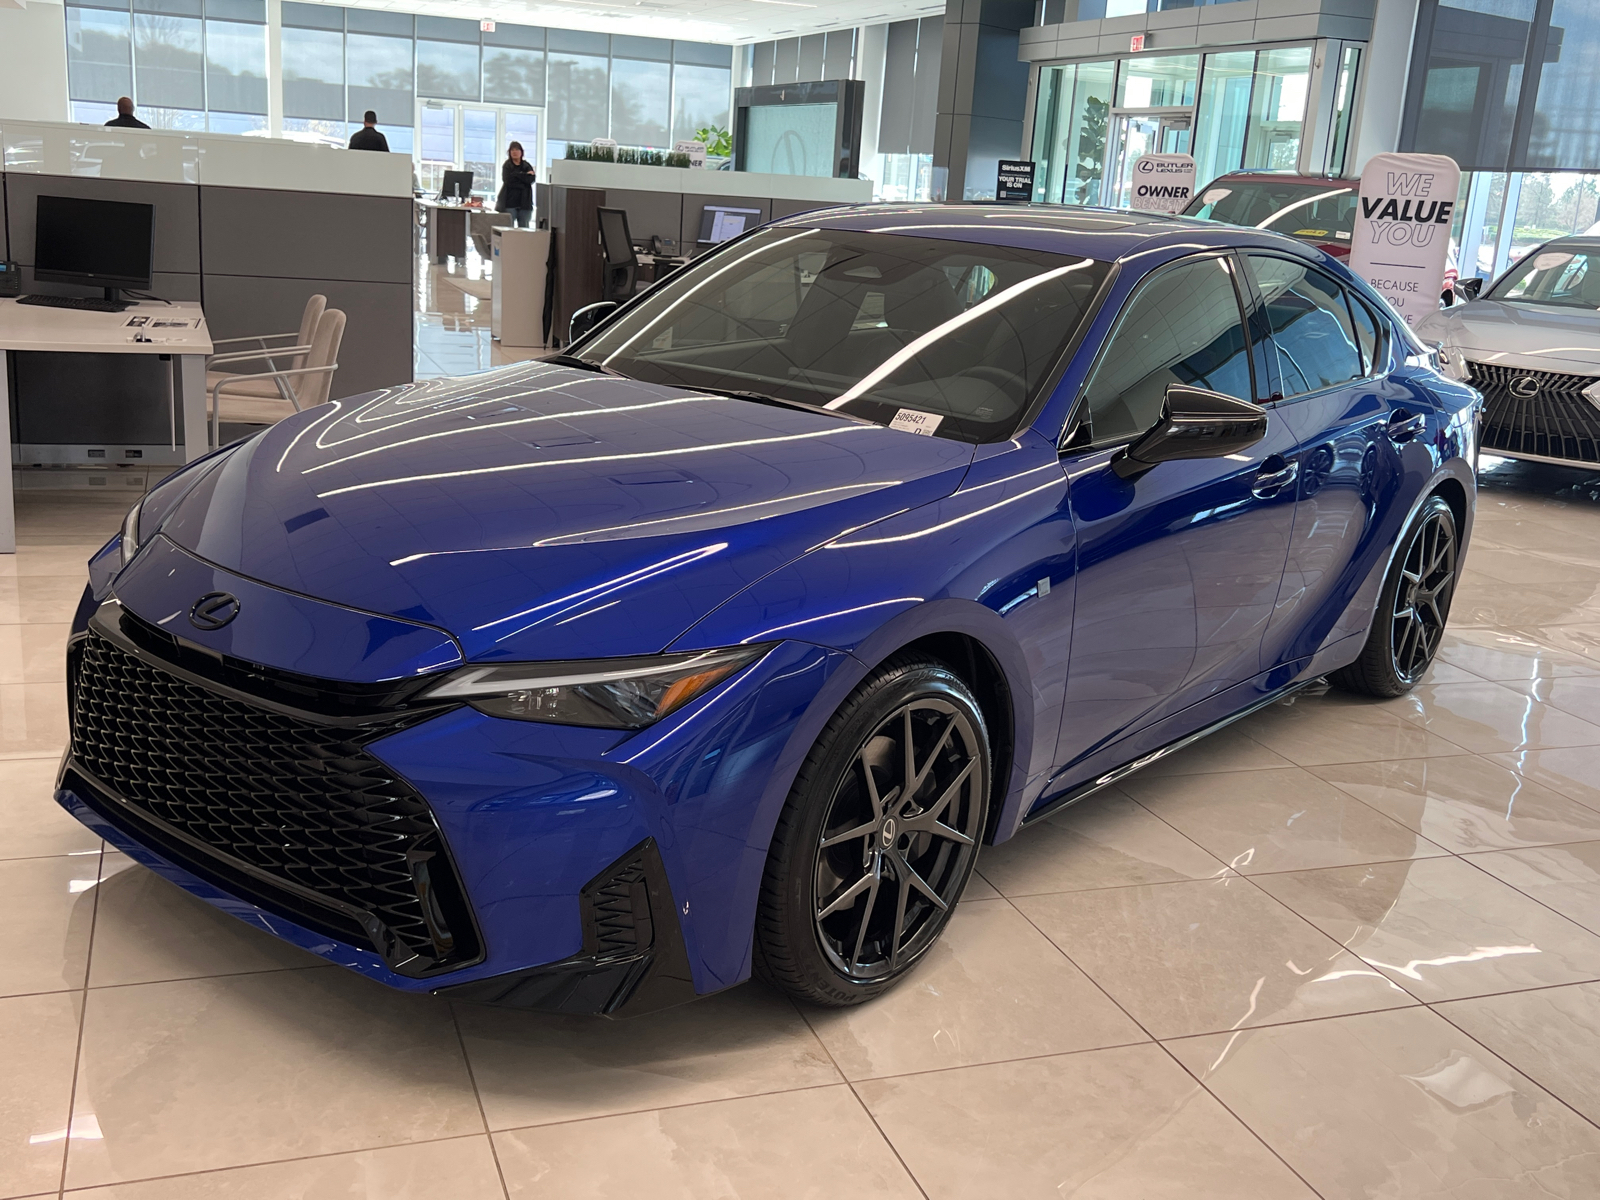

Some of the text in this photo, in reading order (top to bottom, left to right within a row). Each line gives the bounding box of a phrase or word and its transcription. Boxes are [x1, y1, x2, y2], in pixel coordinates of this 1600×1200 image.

[1001, 164, 1031, 172] SiriusXM
[1387, 171, 1434, 197] WE
[1137, 185, 1190, 199] OWNER
[1361, 196, 1454, 224] VALUE
[1370, 220, 1436, 248] YOU
[1370, 278, 1419, 292] BECAUSE
[1386, 296, 1405, 308] OU
[895, 412, 927, 425] 5095421
